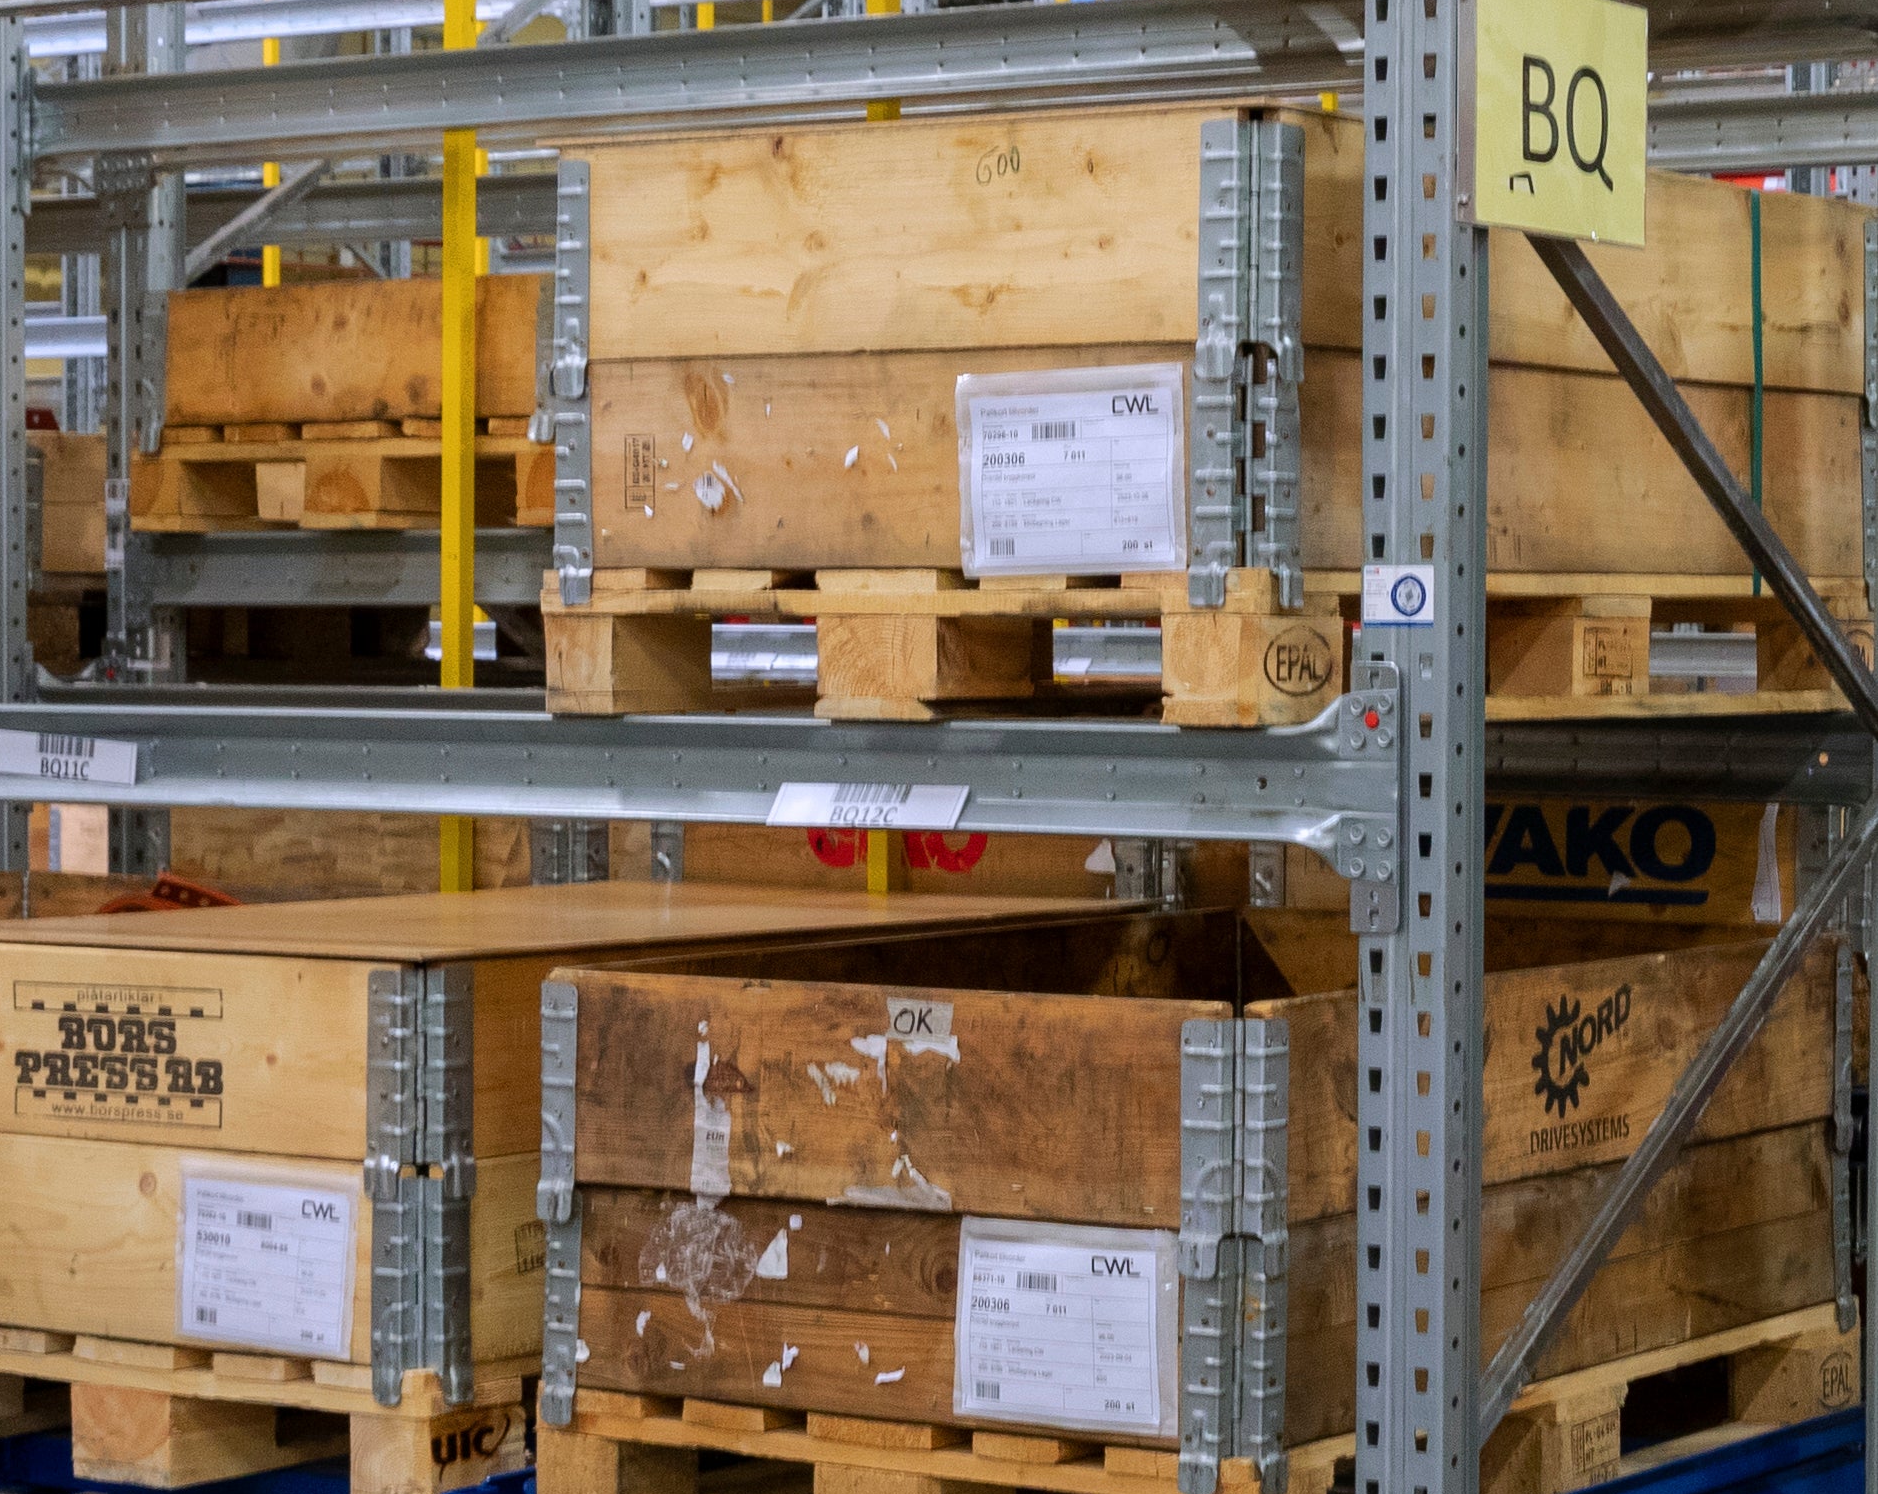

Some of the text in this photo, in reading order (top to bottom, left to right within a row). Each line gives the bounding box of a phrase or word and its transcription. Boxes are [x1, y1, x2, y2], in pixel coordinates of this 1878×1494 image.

[1523, 52, 1614, 192] BQ
[975, 145, 1020, 187] 600
[1112, 393, 1159, 416] CWL
[983, 452, 1026, 468] 200306
[1122, 539, 1139, 550] 200
[1276, 643, 1324, 683] EPAL
[40, 757, 90, 782] BQ11C
[828, 806, 898, 827] BQ12C
[893, 1007, 933, 1035] OK
[1558, 982, 1632, 1078] NORD
[58, 1015, 178, 1055] BORS
[15, 1050, 224, 1095] PRESS AB
[1530, 1113, 1631, 1155] DRIVESYSTEMS
[301, 1199, 341, 1224] CWL
[1091, 1255, 1141, 1278] CWL
[971, 1295, 1010, 1314] 200306
[1823, 1362, 1853, 1399] EPAL
[1104, 1399, 1121, 1411] 200
